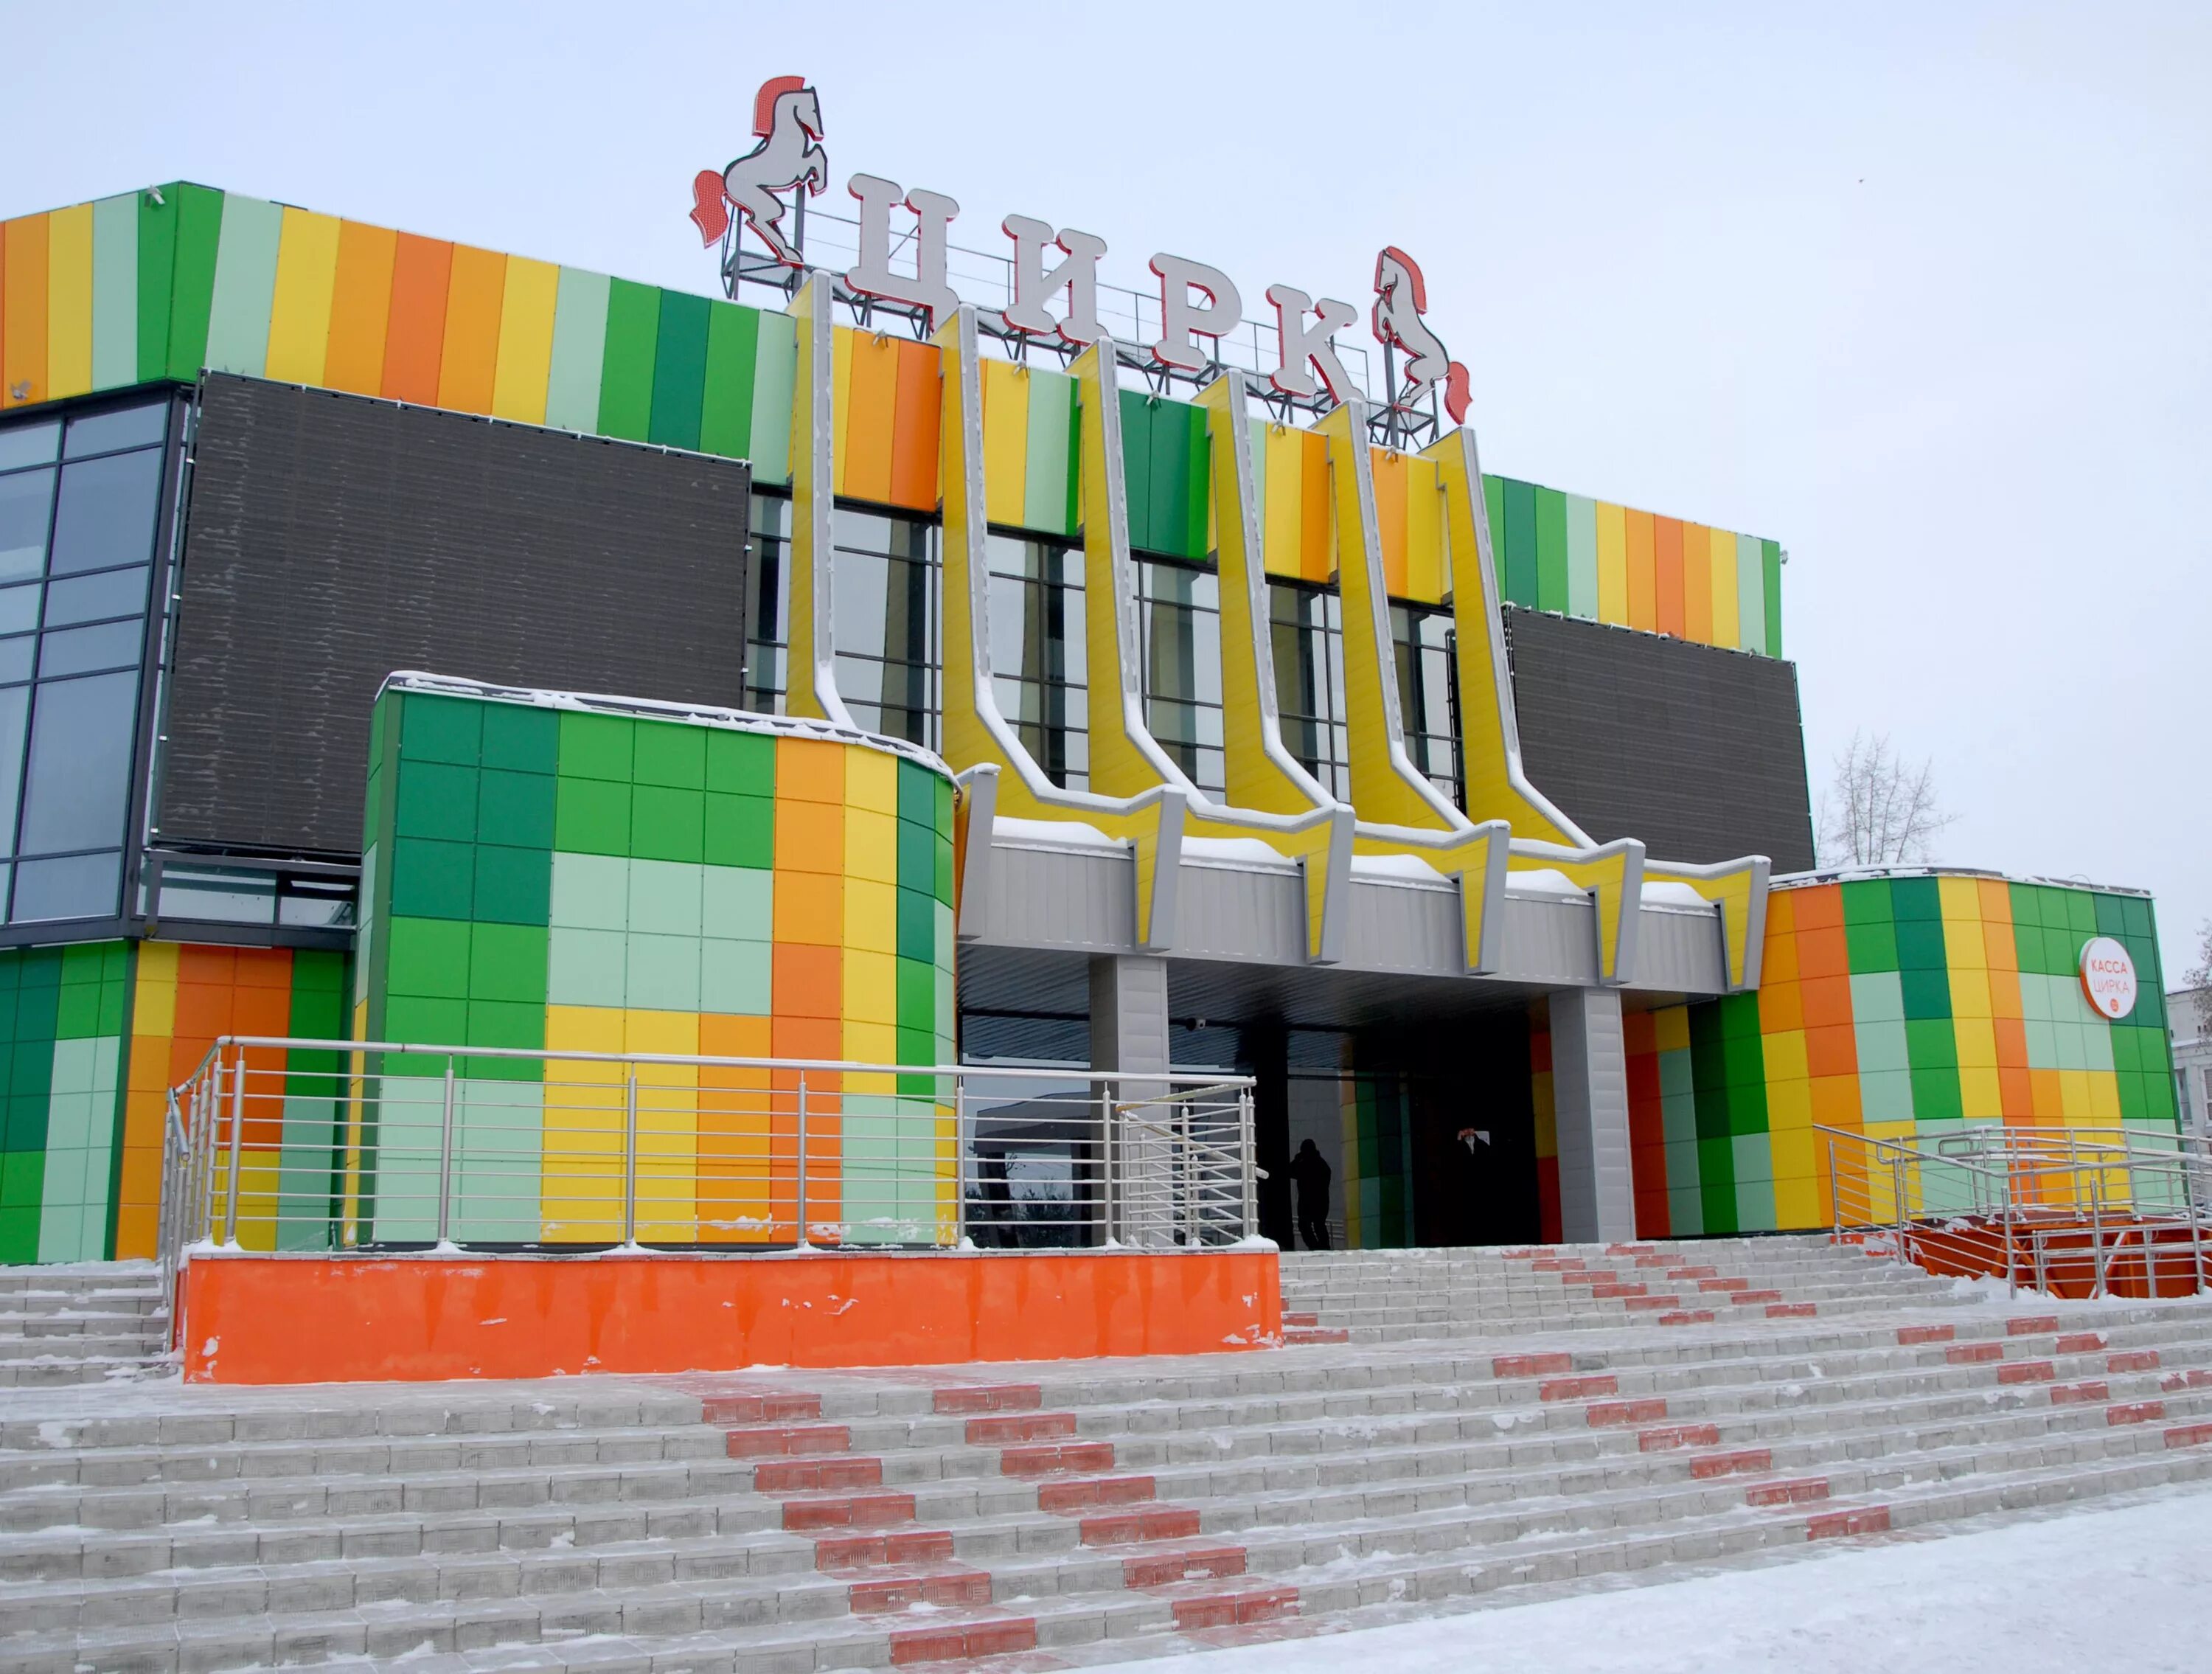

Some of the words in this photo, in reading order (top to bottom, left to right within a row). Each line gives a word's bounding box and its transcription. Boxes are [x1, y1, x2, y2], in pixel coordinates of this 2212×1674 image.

[845, 173, 1365, 403] ЦИРК
[2091, 959, 2127, 973] КАССА
[2094, 979, 2129, 993] ЦИРКА
